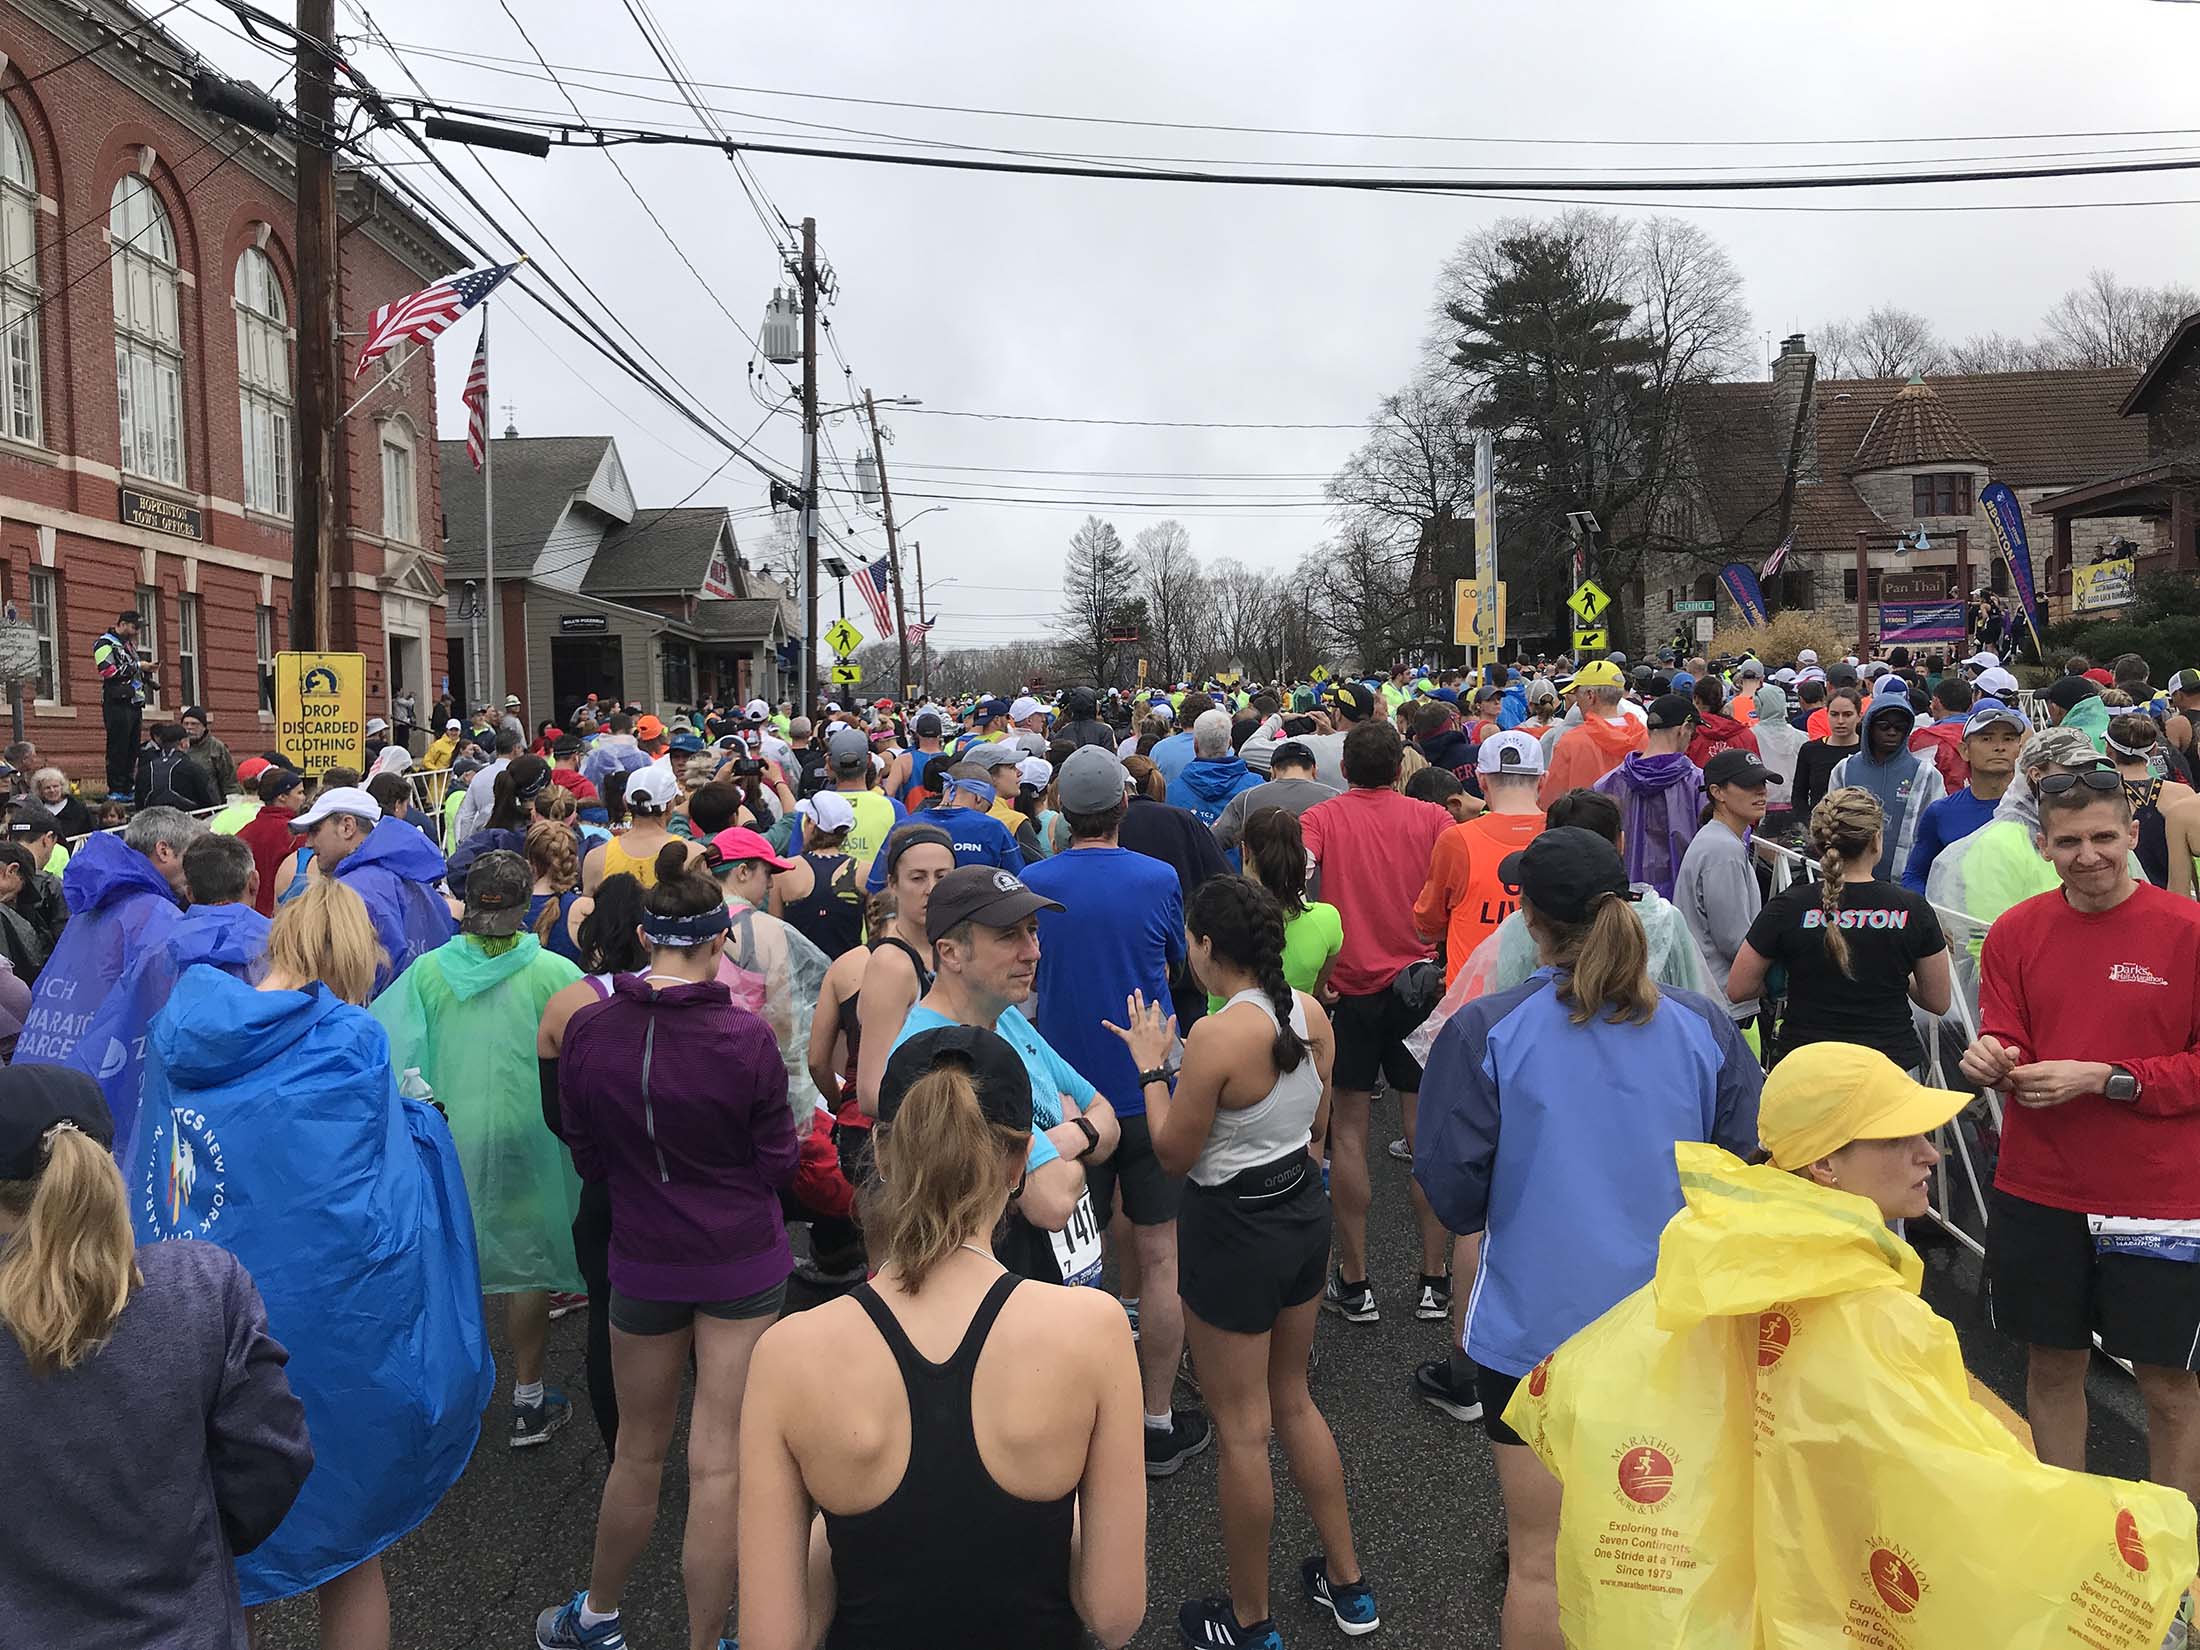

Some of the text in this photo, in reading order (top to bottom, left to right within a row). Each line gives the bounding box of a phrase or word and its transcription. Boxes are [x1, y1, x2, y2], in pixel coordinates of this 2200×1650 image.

[139, 497, 188, 520] HOPKINTON
[132, 510, 195, 536] TOWN OFFICES
[1886, 579, 1941, 594] Pan Thai
[303, 704, 341, 718] DROP
[282, 721, 360, 735] DISCARDED
[285, 737, 356, 752] CLOTHING
[304, 754, 339, 769] HERE
[953, 842, 982, 852] ORN
[1480, 900, 1516, 924] LIV
[1800, 907, 1909, 929] BOSTON
[2110, 964, 2149, 980] Parks
[38, 976, 78, 1000] ICH
[174, 1107, 206, 1131] TCS
[203, 1129, 225, 1173] NEW
[200, 1181, 225, 1234] YORK
[2092, 1221, 2103, 1232] 7
[1063, 1259, 1072, 1274] 7
[1610, 1434, 1684, 1465] MARATHON
[1608, 1521, 1680, 1538] Exploring the
[1599, 1534, 1692, 1554] Seven Continents
[1594, 1547, 1697, 1569] One Stride at a Time
[1616, 1563, 1673, 1580] Since 1979
[1599, 1578, 1684, 1595] www.marathontours.com
[2080, 1580, 2110, 1604] Seven
[2093, 1571, 2140, 1607] Exploring
[2070, 1591, 2087, 1609] One
[2088, 1603, 2118, 1627] Stride
[2084, 1617, 2113, 1639] Since
